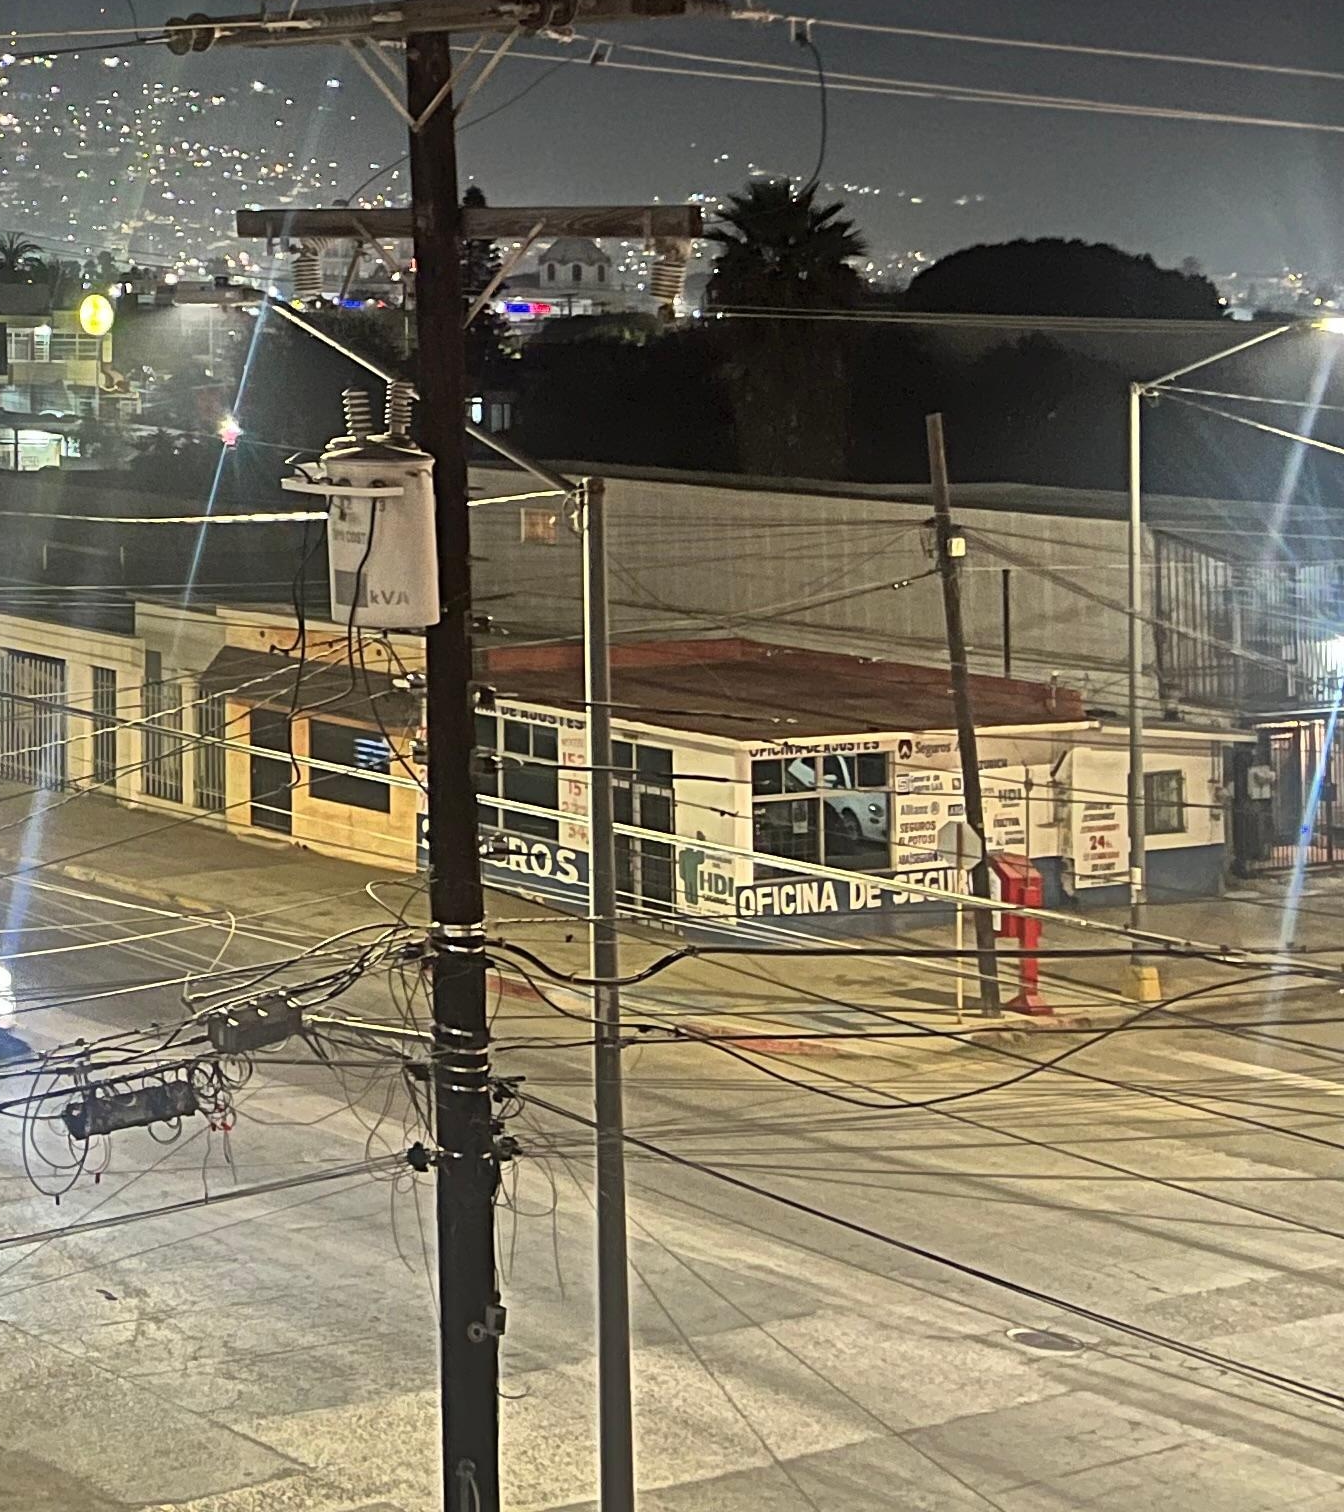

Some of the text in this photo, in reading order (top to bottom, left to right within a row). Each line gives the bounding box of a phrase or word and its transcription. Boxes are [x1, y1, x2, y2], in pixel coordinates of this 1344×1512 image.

[369, 590, 410, 606] kVA
[915, 740, 952, 759] Seguros
[900, 820, 937, 834] SEGUROS
[1089, 835, 1105, 851] 24
[698, 870, 734, 898] HDI
[739, 868, 974, 917] OFICINA DE SEGUR
